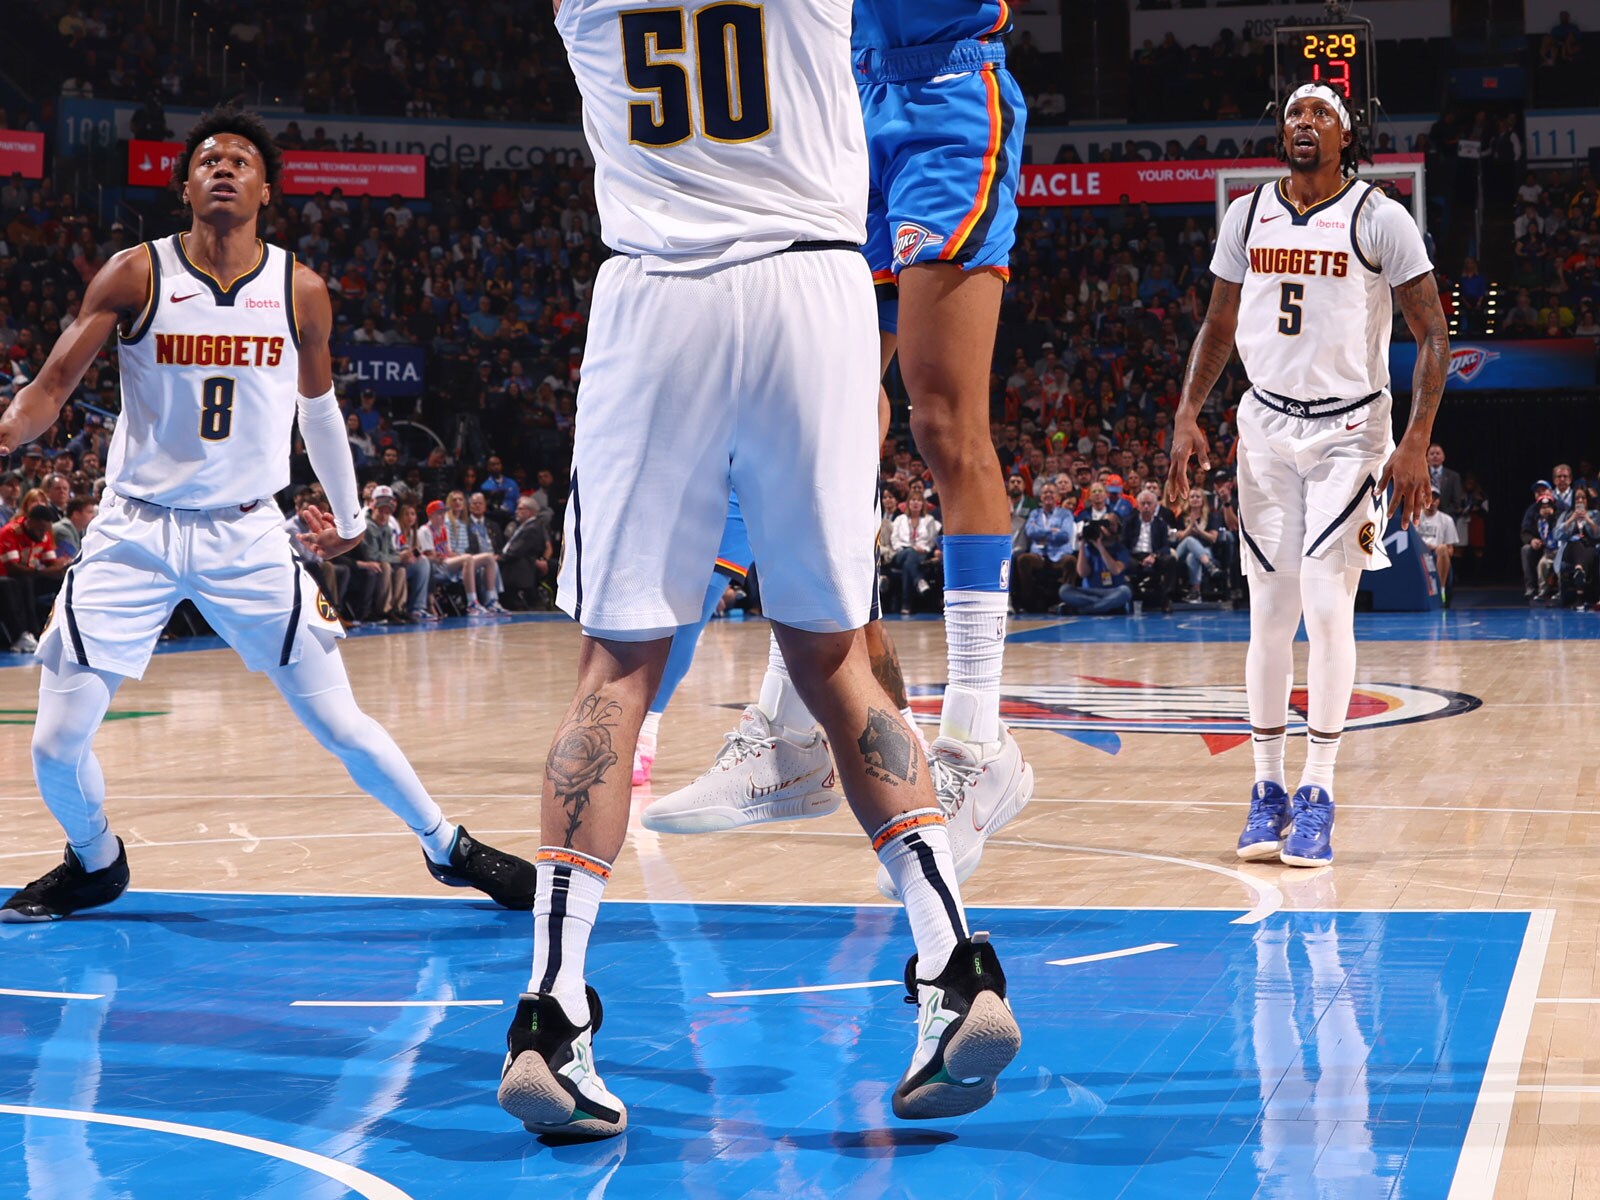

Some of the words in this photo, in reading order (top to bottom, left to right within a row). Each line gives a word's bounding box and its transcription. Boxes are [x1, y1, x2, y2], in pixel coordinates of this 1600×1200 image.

[1304, 34, 1356, 59] 2:29
[617, 0, 774, 149] 50
[1532, 128, 1585, 156] 111
[1137, 168, 1175, 181] YOUR
[1315, 218, 1345, 229] ibotta
[1249, 247, 1348, 278] NUGGETS
[245, 298, 280, 309] ibotta
[1277, 282, 1304, 336] 5
[155, 333, 285, 368] NUGGETS
[348, 360, 421, 381] LTRA
[200, 375, 235, 442] 8
